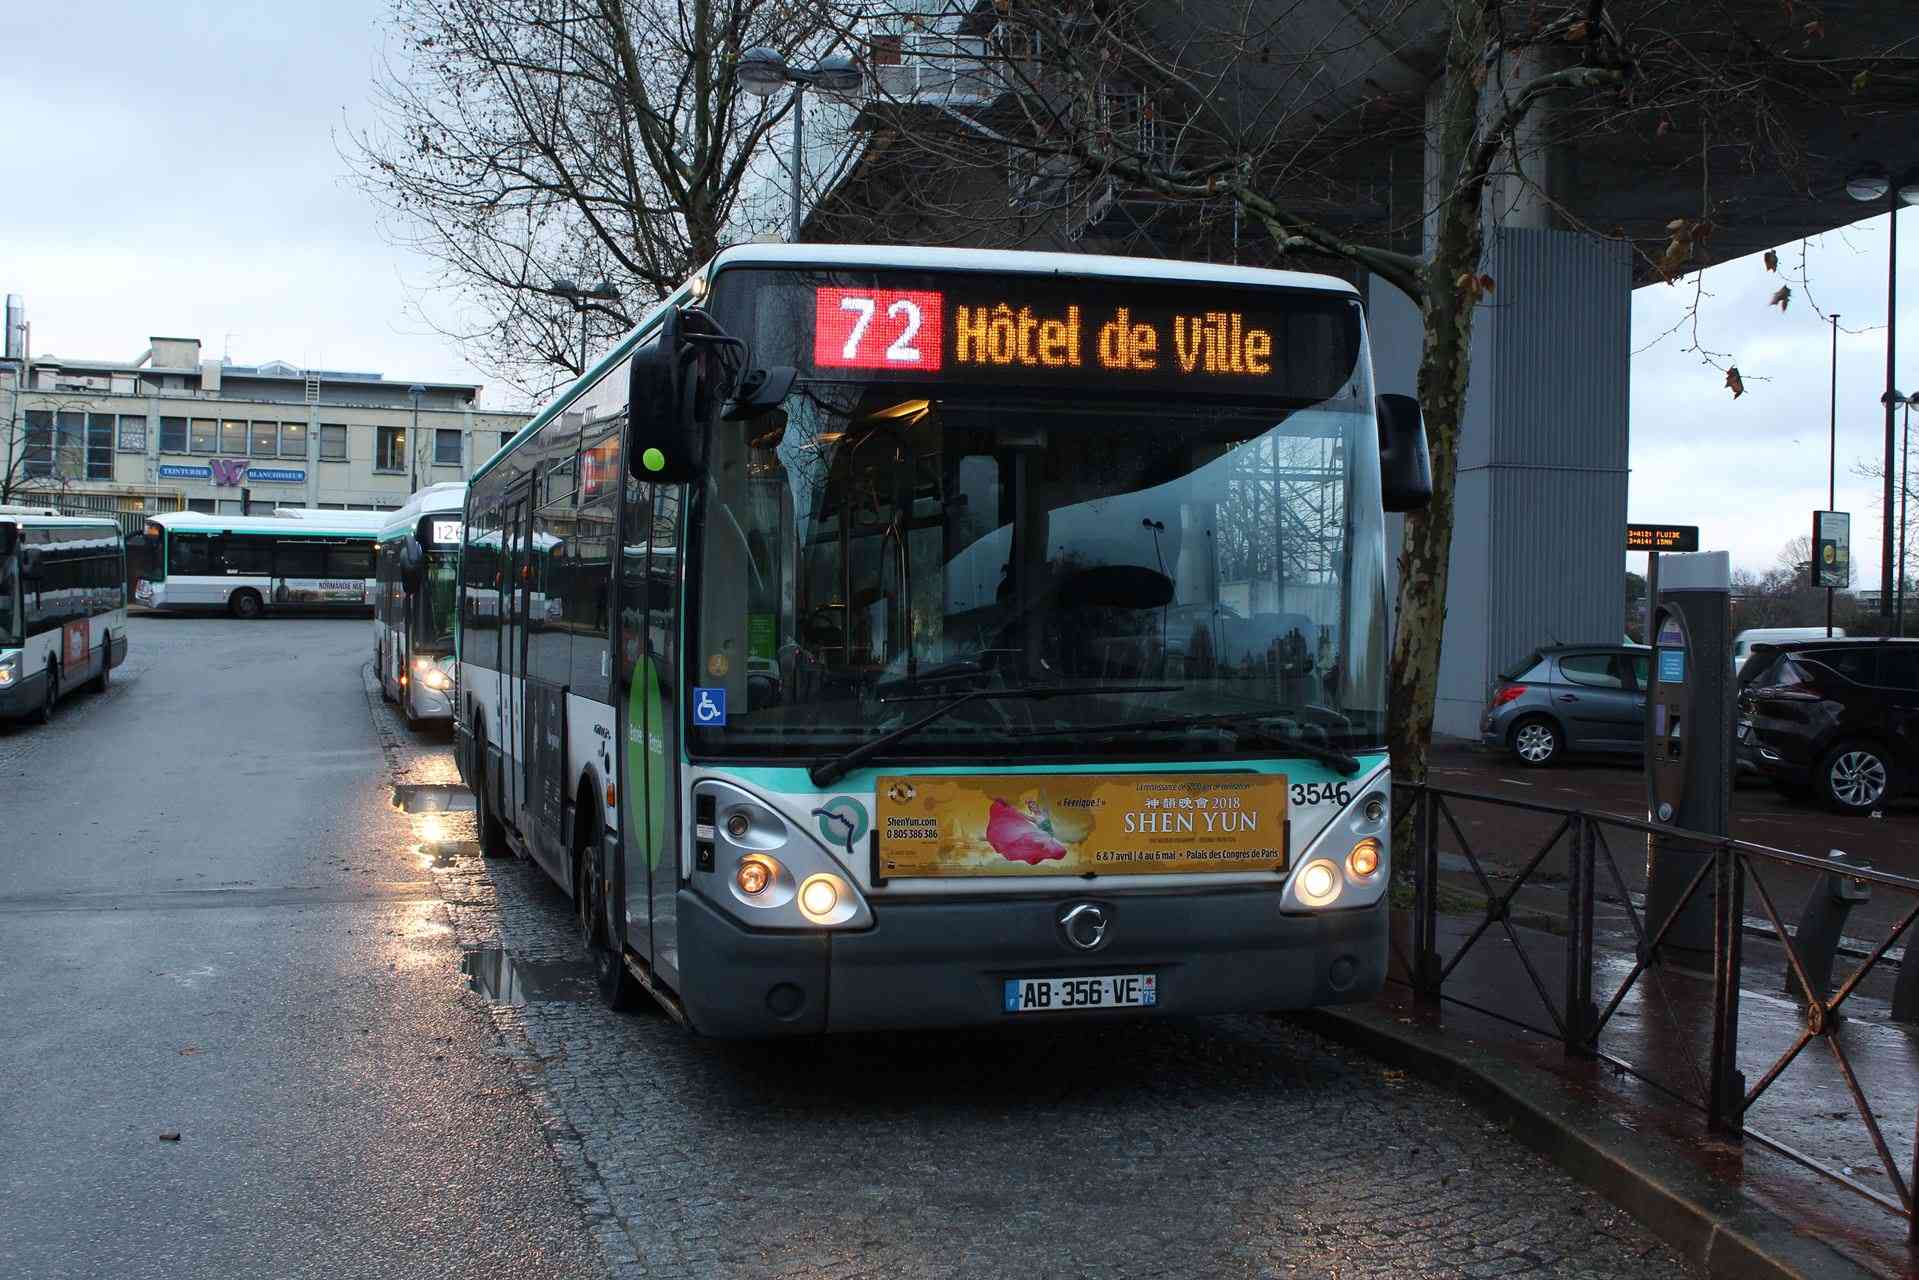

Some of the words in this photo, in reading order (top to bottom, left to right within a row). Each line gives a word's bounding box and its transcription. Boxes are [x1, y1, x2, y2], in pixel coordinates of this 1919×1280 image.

[838, 296, 922, 362] 72
[955, 302, 1081, 367] Hôtel
[1097, 307, 1158, 370] de
[1174, 312, 1272, 375] Ville
[1290, 781, 1352, 806] 3546
[1212, 797, 1240, 809] 2018
[887, 817, 937, 827] ShenYun.com
[1124, 813, 1193, 833] SHEN
[1203, 811, 1257, 832] YUN
[923, 829, 938, 838] 386
[1116, 851, 1132, 861] avril
[1161, 850, 1176, 860] mai
[1186, 850, 1208, 859] Palais
[1208, 850, 1222, 859] des
[1251, 849, 1261, 858] de
[1261, 848, 1279, 858] Paris
